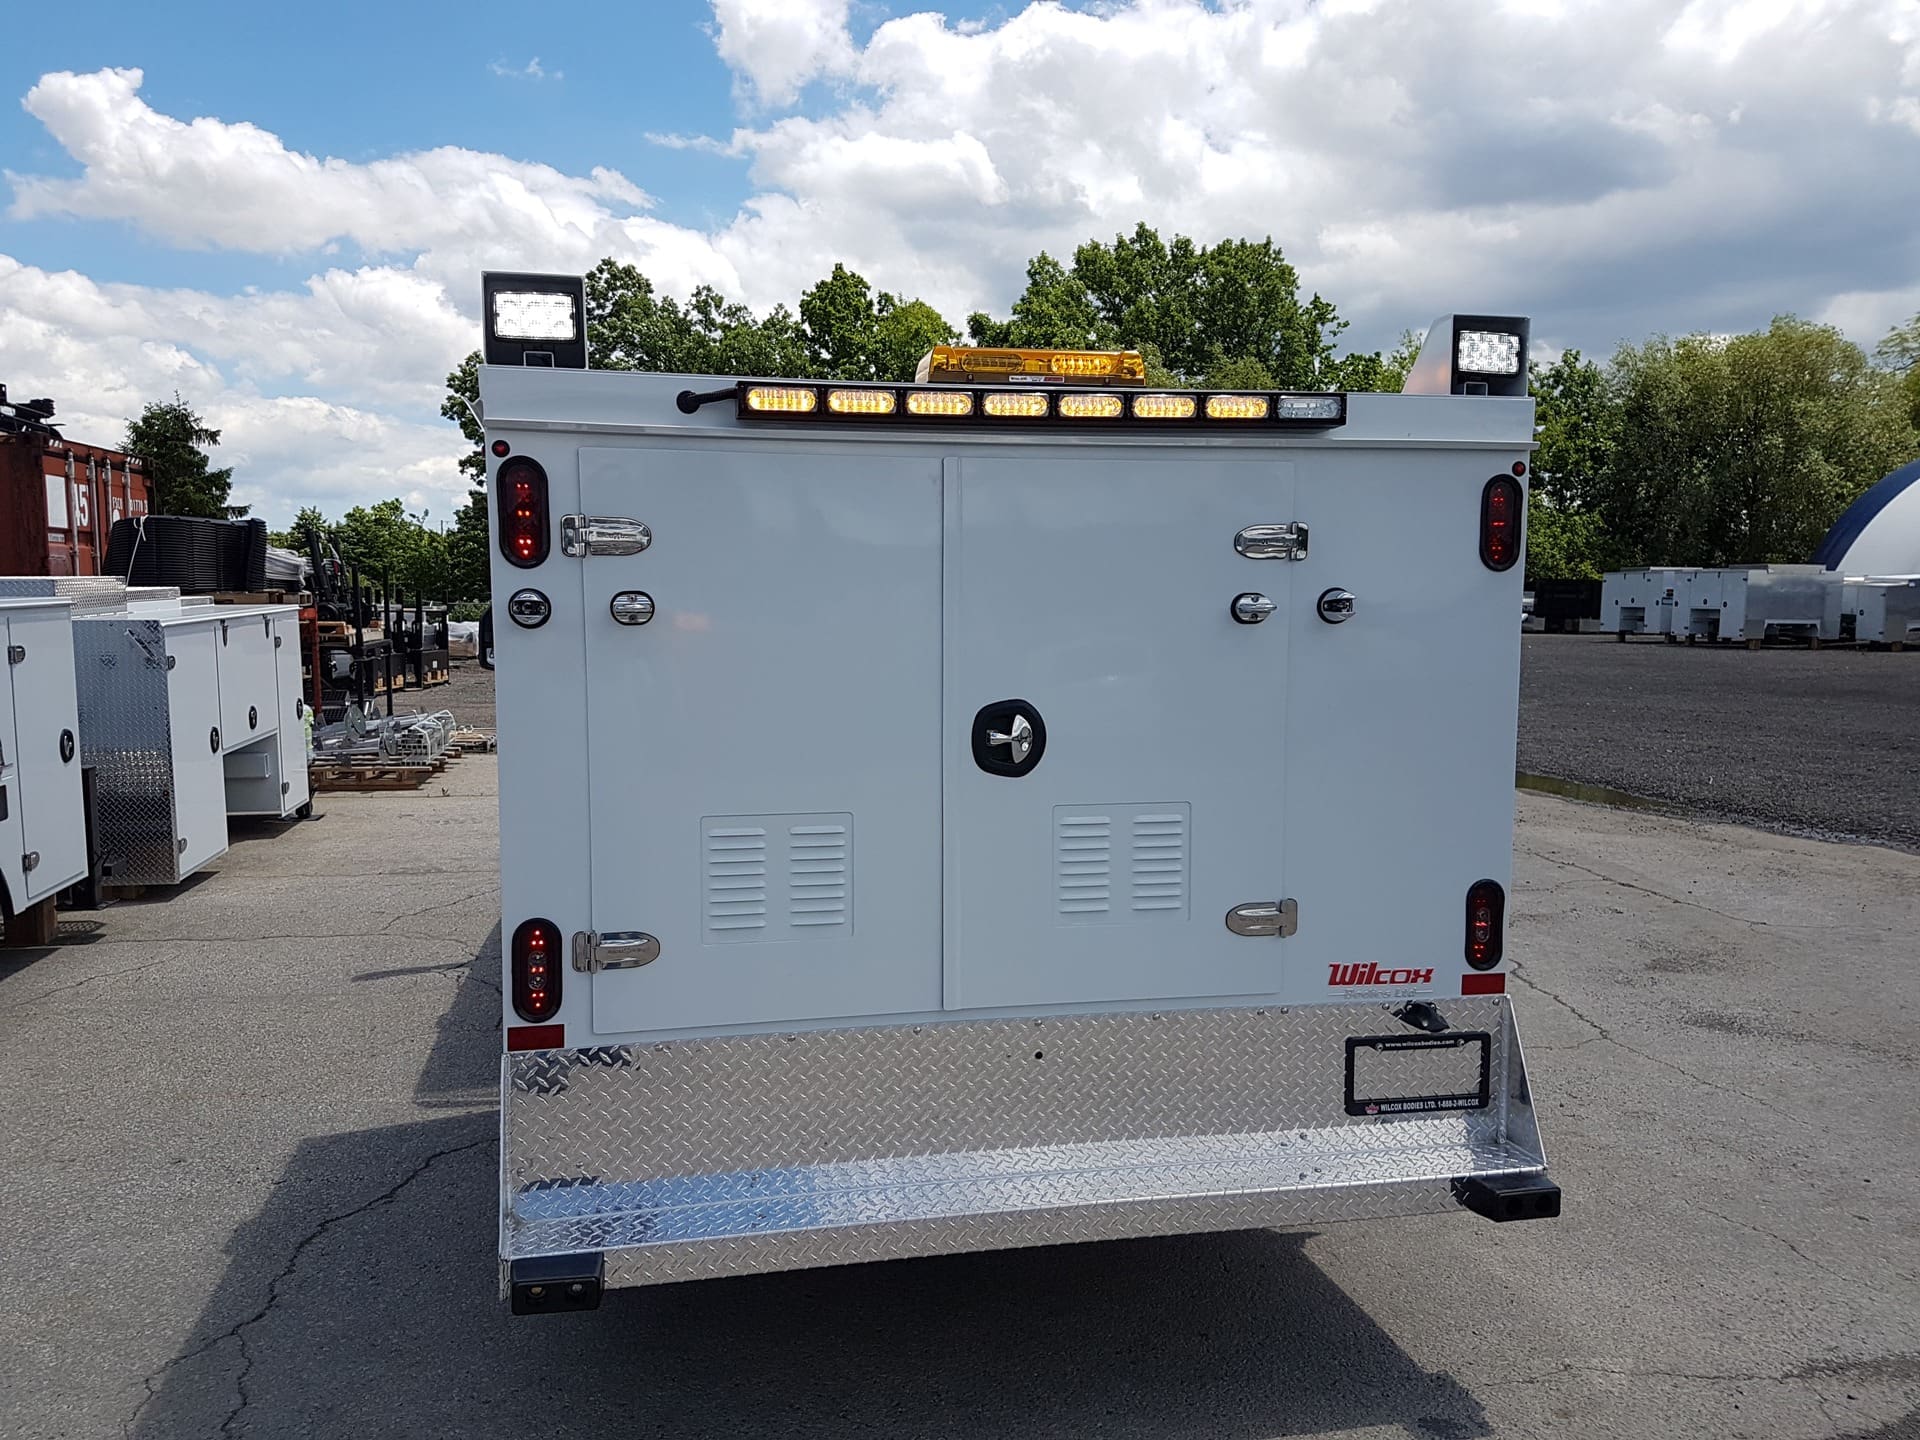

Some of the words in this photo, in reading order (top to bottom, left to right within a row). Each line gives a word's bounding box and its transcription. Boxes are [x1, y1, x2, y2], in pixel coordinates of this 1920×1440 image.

[1328, 962, 1434, 986] Wilcox
[1344, 988, 1391, 999] Bodies
[1380, 1102, 1402, 1111] WILCOX
[1402, 1101, 1424, 1110] BODIES
